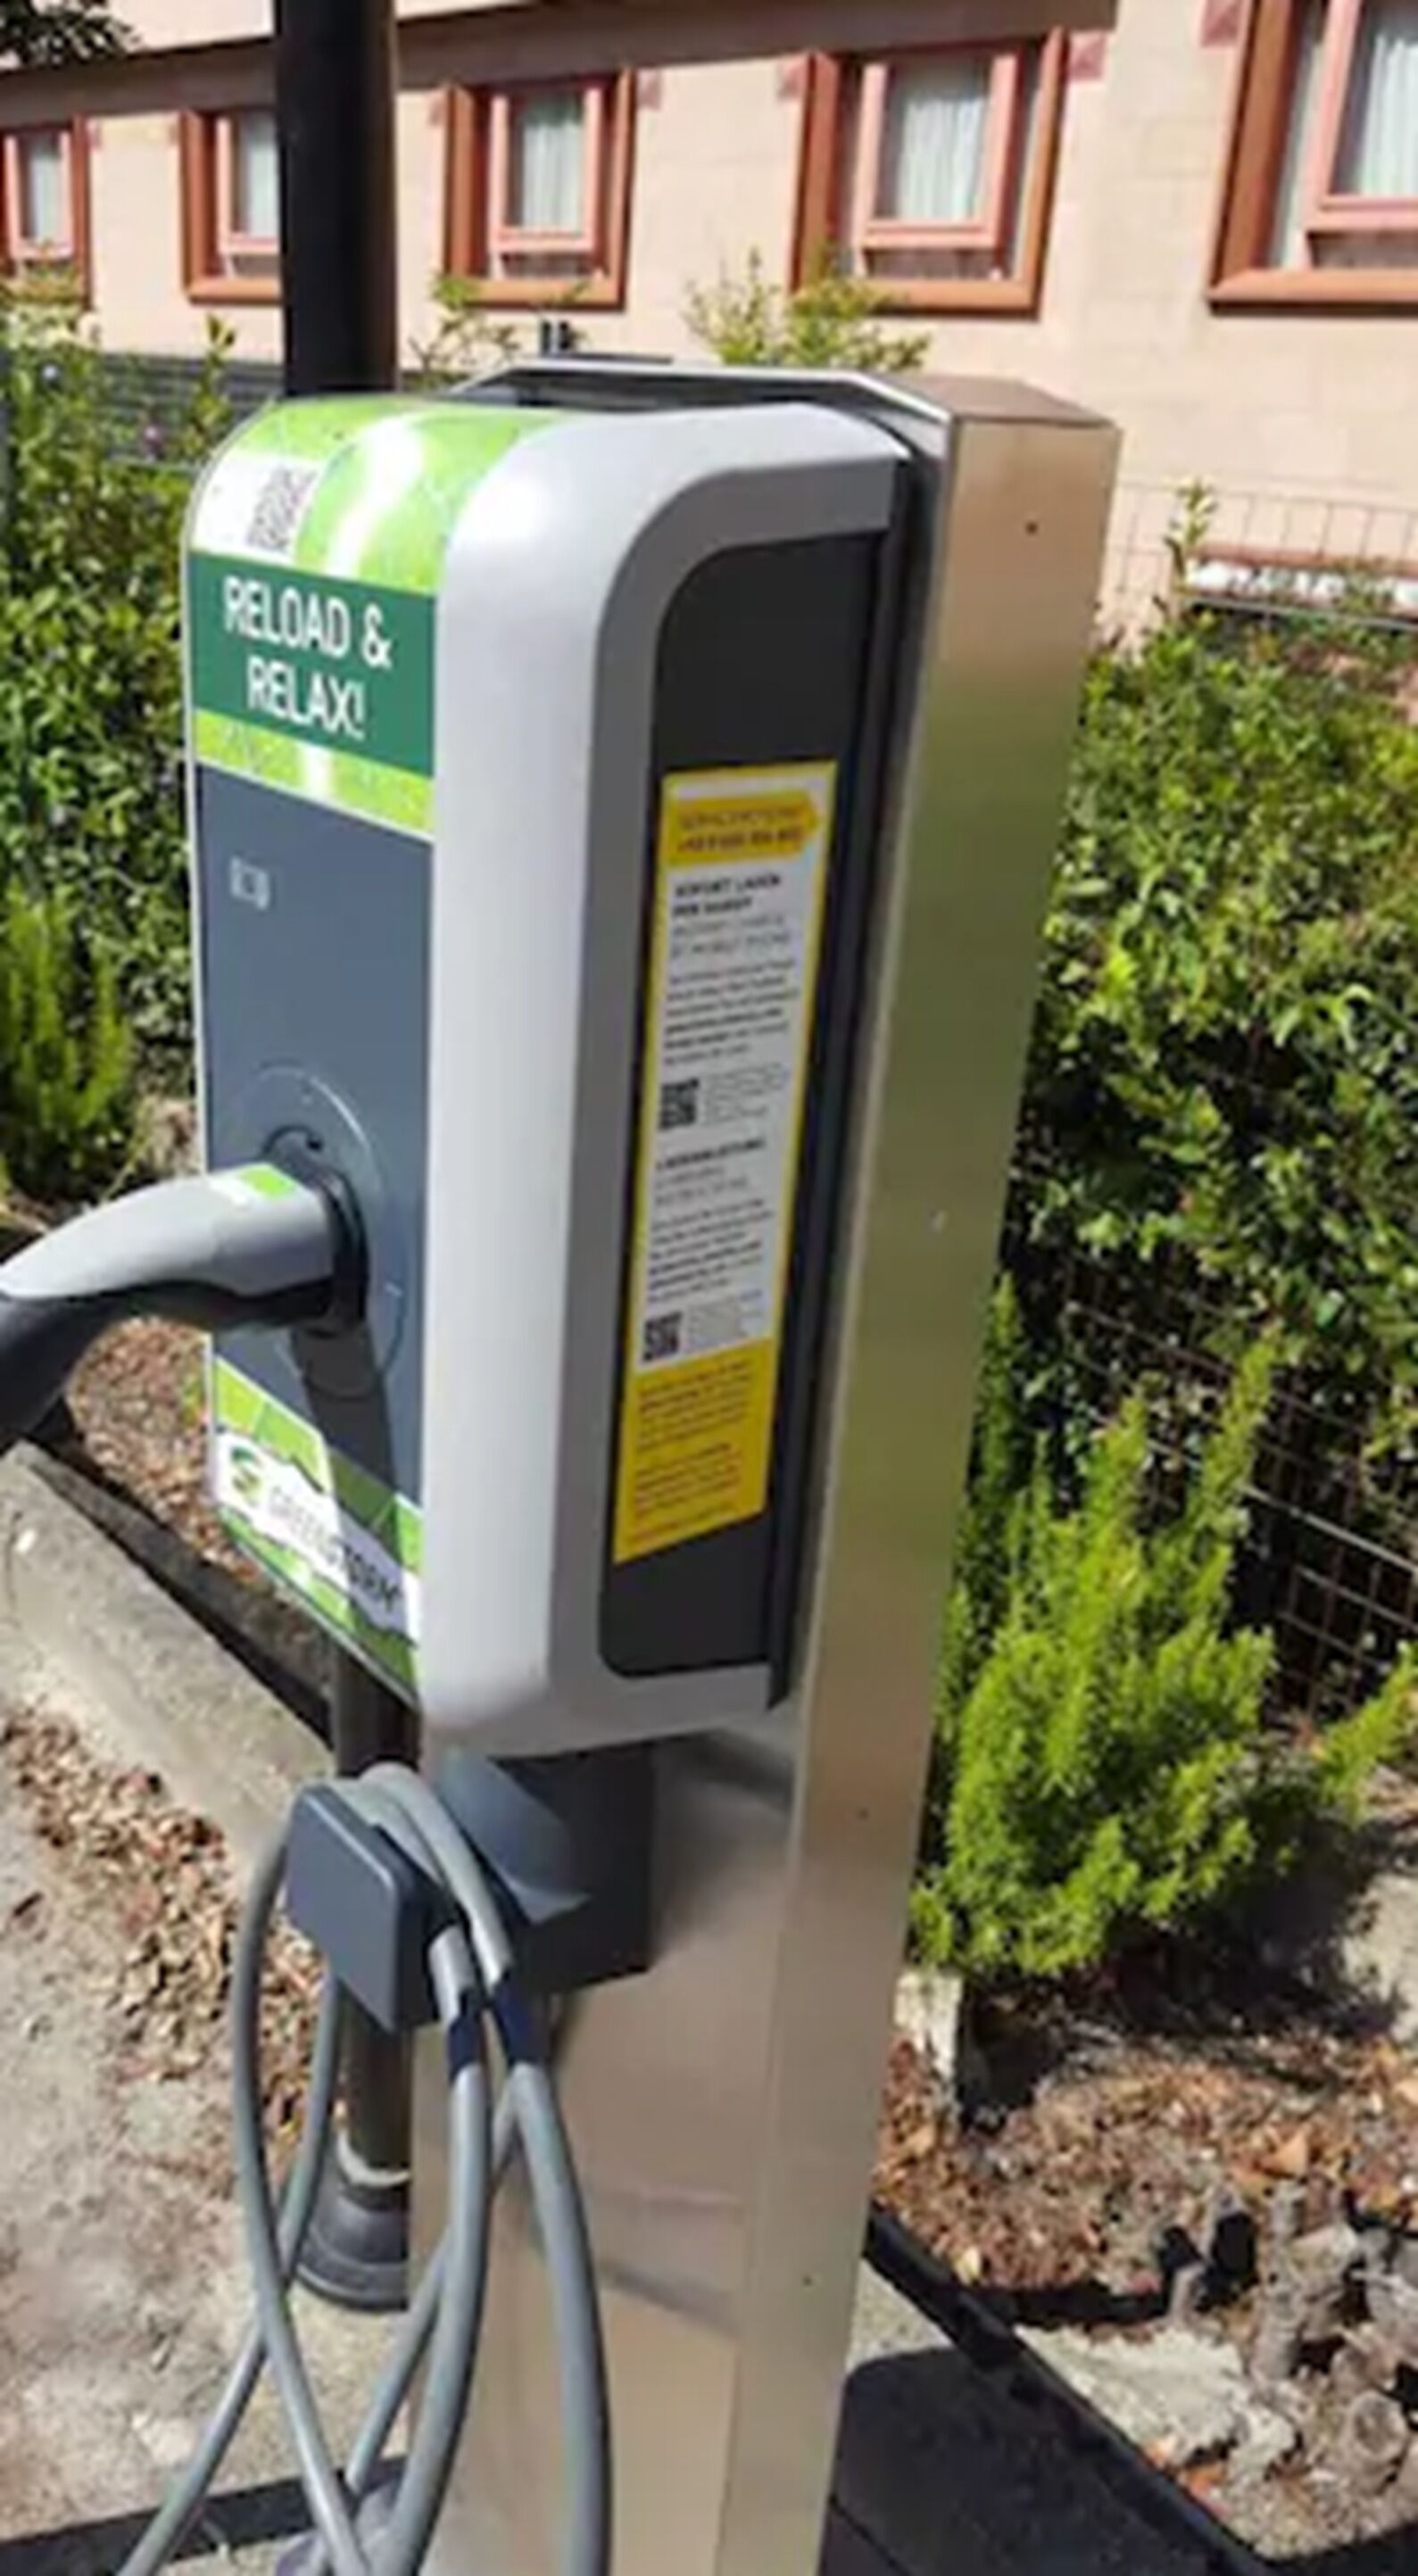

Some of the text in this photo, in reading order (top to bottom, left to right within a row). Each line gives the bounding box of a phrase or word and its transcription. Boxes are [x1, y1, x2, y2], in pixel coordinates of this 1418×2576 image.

[224, 576, 393, 669] RELOAD &
[247, 656, 366, 741] RELAX!
